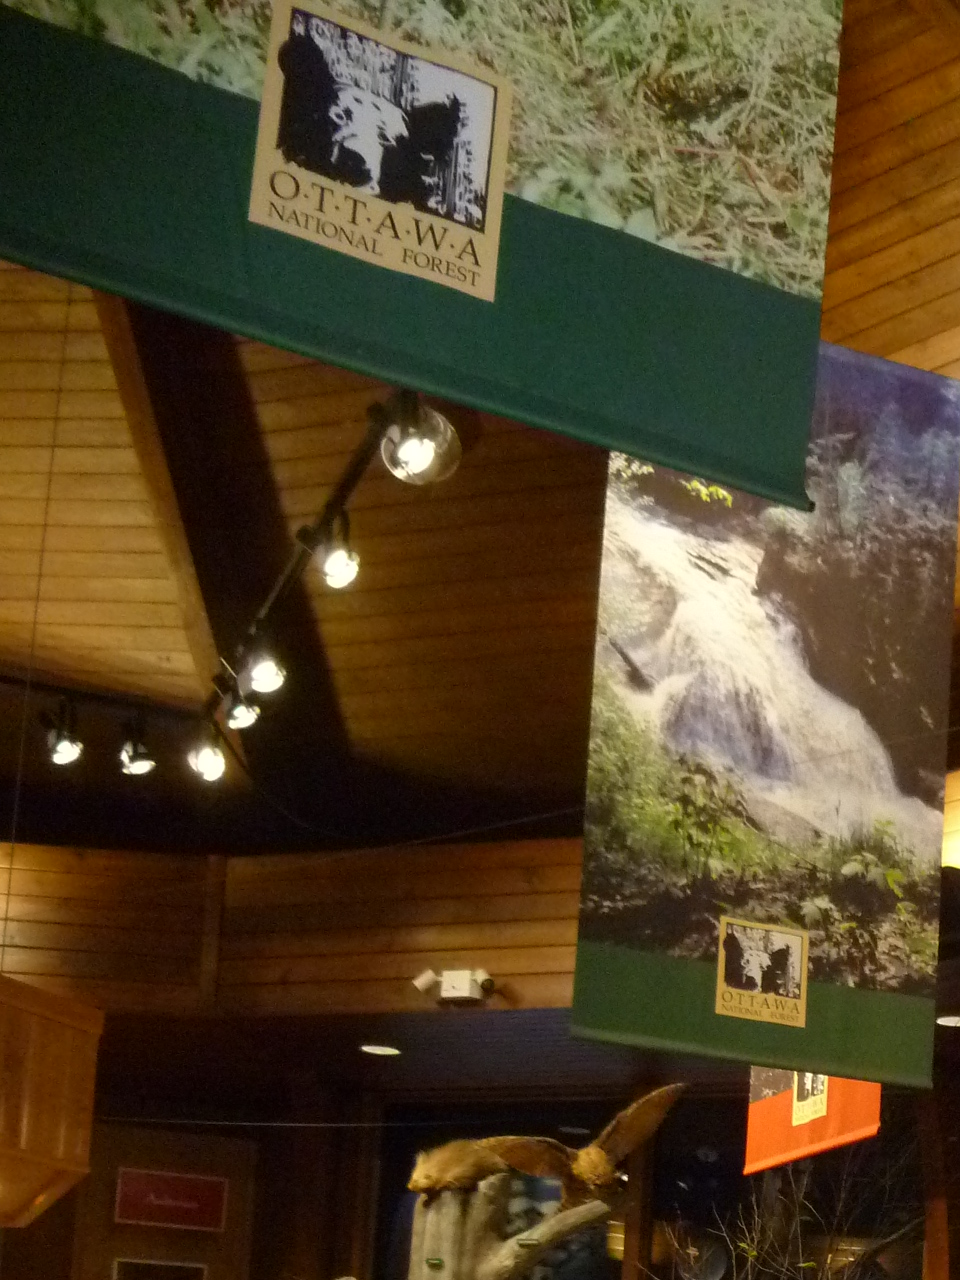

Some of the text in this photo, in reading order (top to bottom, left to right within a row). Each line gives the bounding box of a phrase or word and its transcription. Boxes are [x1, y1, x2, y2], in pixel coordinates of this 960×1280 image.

[267, 201, 481, 288] NATIONAL FOREST
[721, 1003, 763, 1018] NATIONAL
